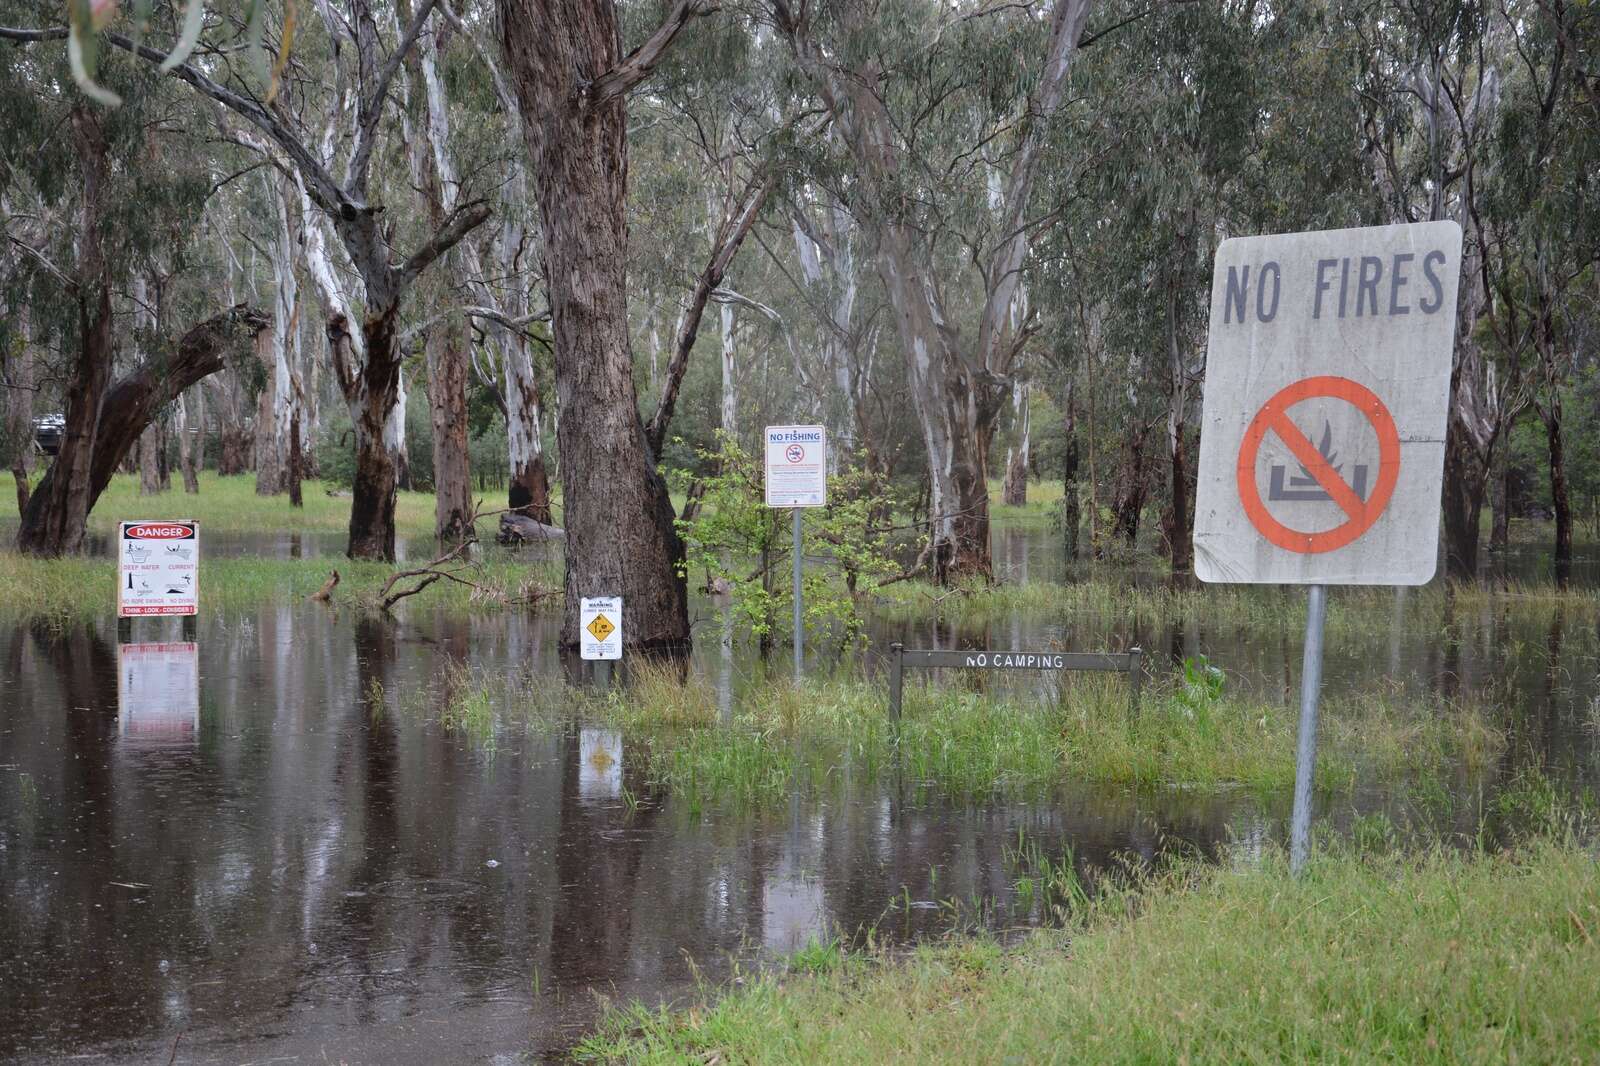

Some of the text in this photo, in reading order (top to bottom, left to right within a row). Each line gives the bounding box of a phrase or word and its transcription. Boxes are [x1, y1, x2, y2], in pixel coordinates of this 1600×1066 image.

[1223, 250, 1447, 324] NO FIRES
[136, 528, 183, 536] DANGER
[966, 653, 1063, 668] NO CAMPING
